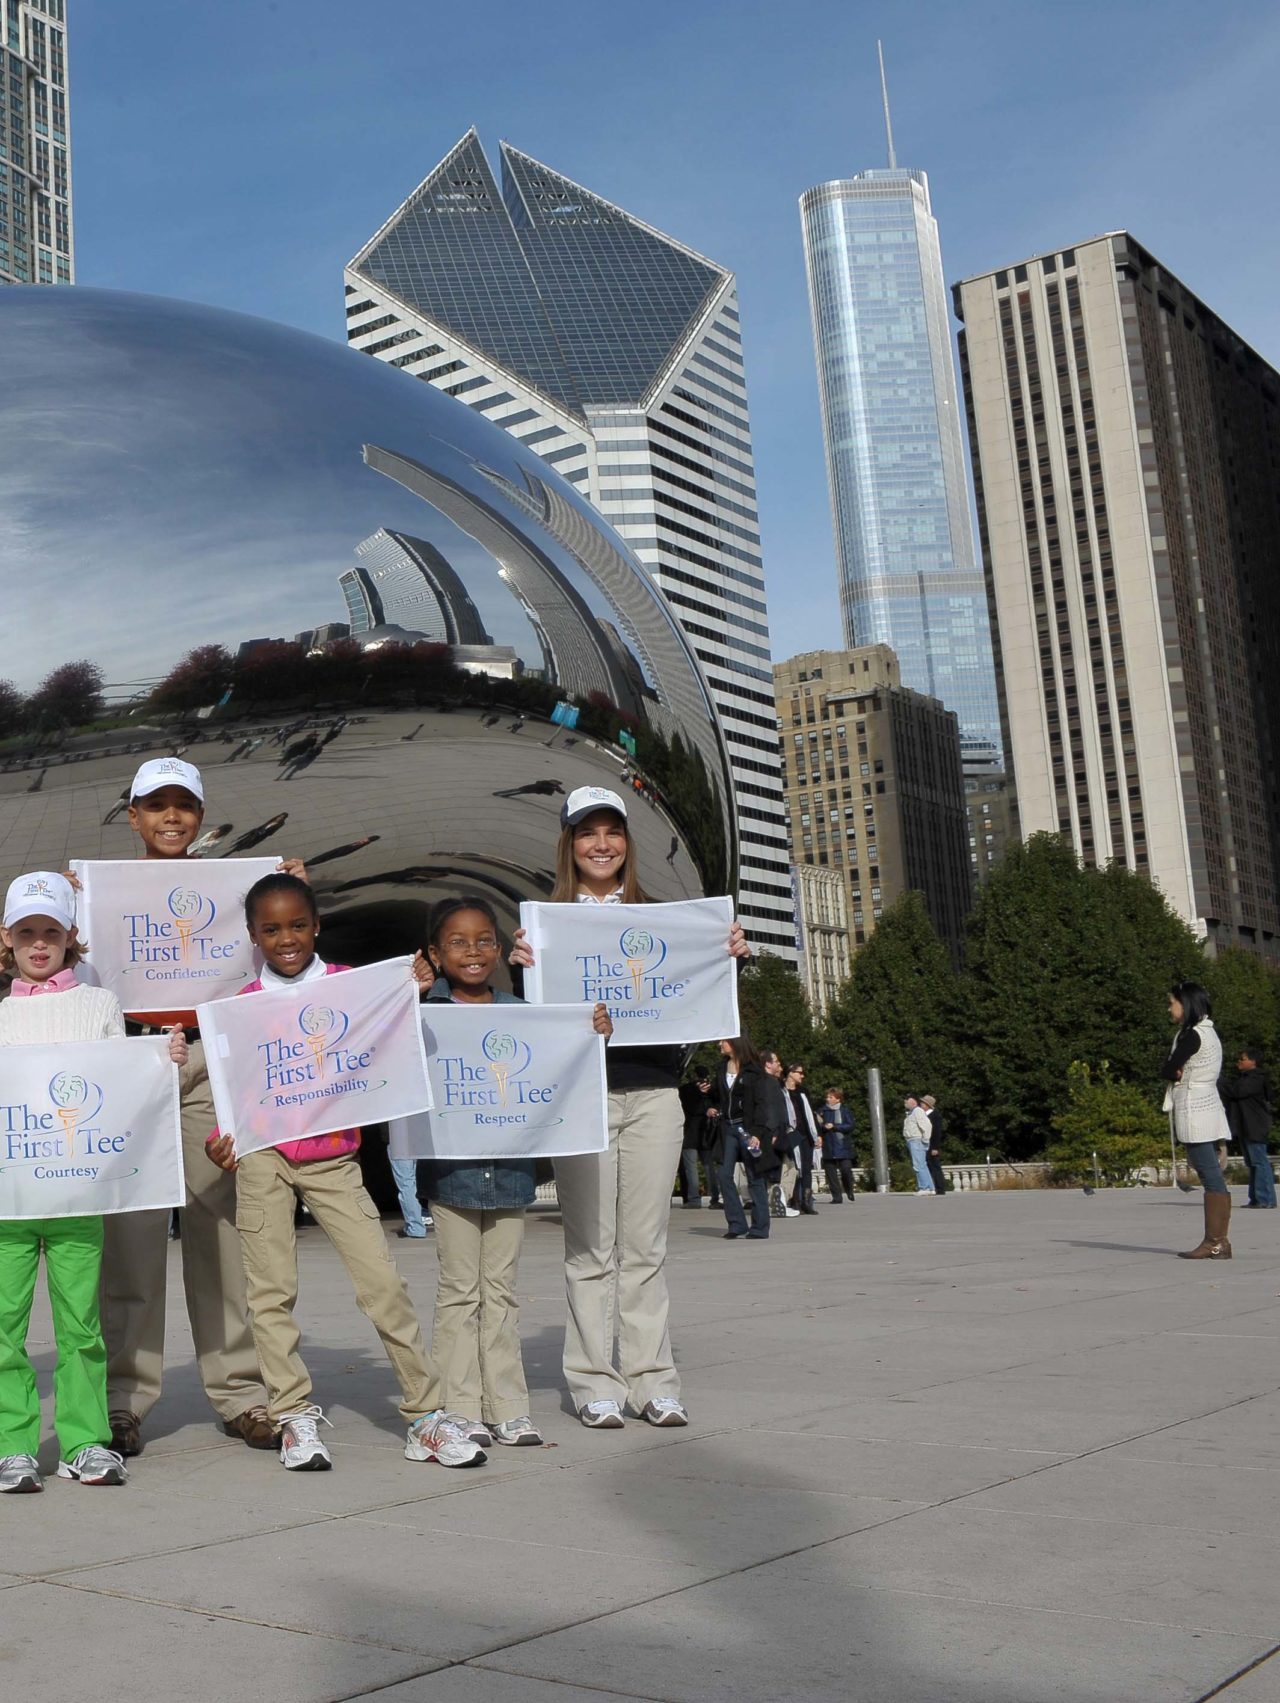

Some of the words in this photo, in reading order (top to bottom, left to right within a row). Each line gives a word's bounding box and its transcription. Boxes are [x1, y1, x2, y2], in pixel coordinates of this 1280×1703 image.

[122, 914, 172, 938] The
[129, 940, 180, 962] First
[145, 968, 221, 980] Confidence
[575, 954, 624, 978] The
[582, 980, 632, 1001] First
[608, 1008, 662, 1020] Honesty
[258, 1038, 304, 1066] The
[265, 1063, 316, 1090] First
[436, 1058, 486, 1082] The
[274, 1078, 369, 1107] Responsibility
[444, 1083, 497, 1106] First
[474, 1113, 526, 1126] Respect
[5, 1133, 64, 1160] First
[34, 1166, 99, 1180] Courtesy
